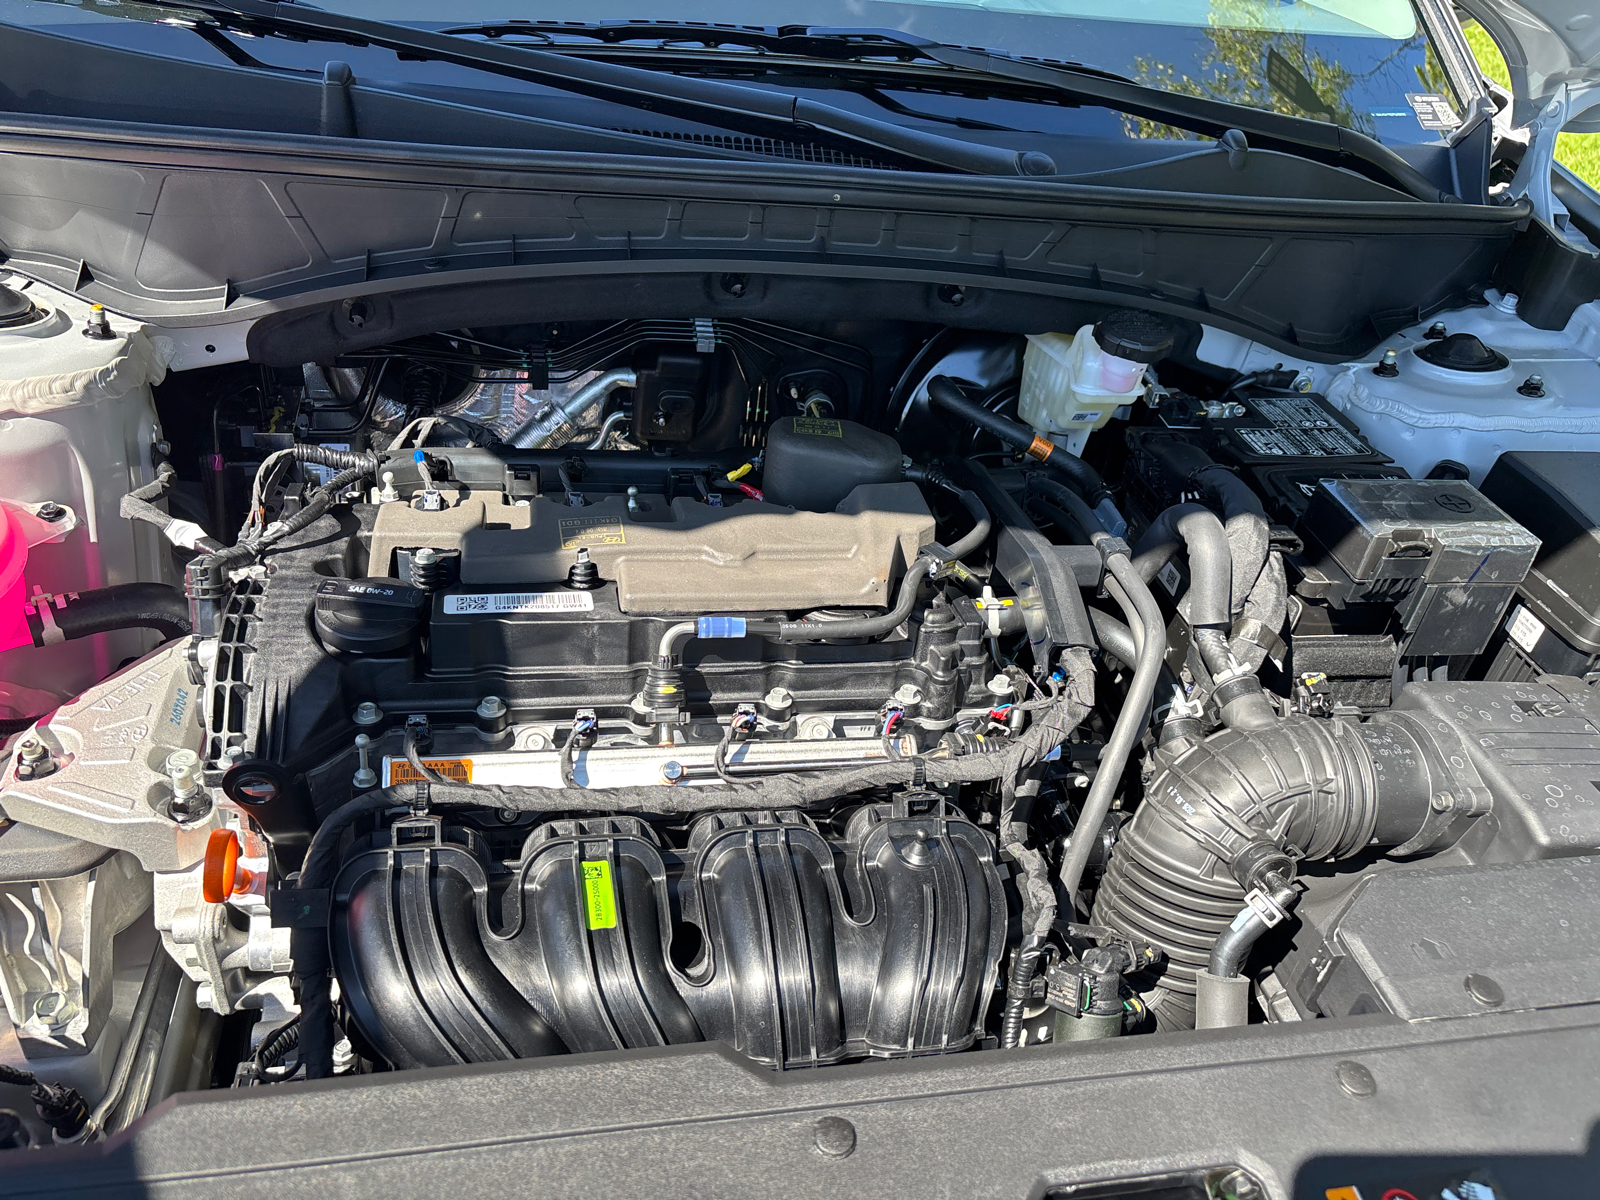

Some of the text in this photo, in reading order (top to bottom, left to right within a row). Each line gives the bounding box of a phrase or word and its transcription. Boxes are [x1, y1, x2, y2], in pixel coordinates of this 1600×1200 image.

[347, 585, 394, 596] SAE 0W-20
[91, 670, 168, 711] THETA
